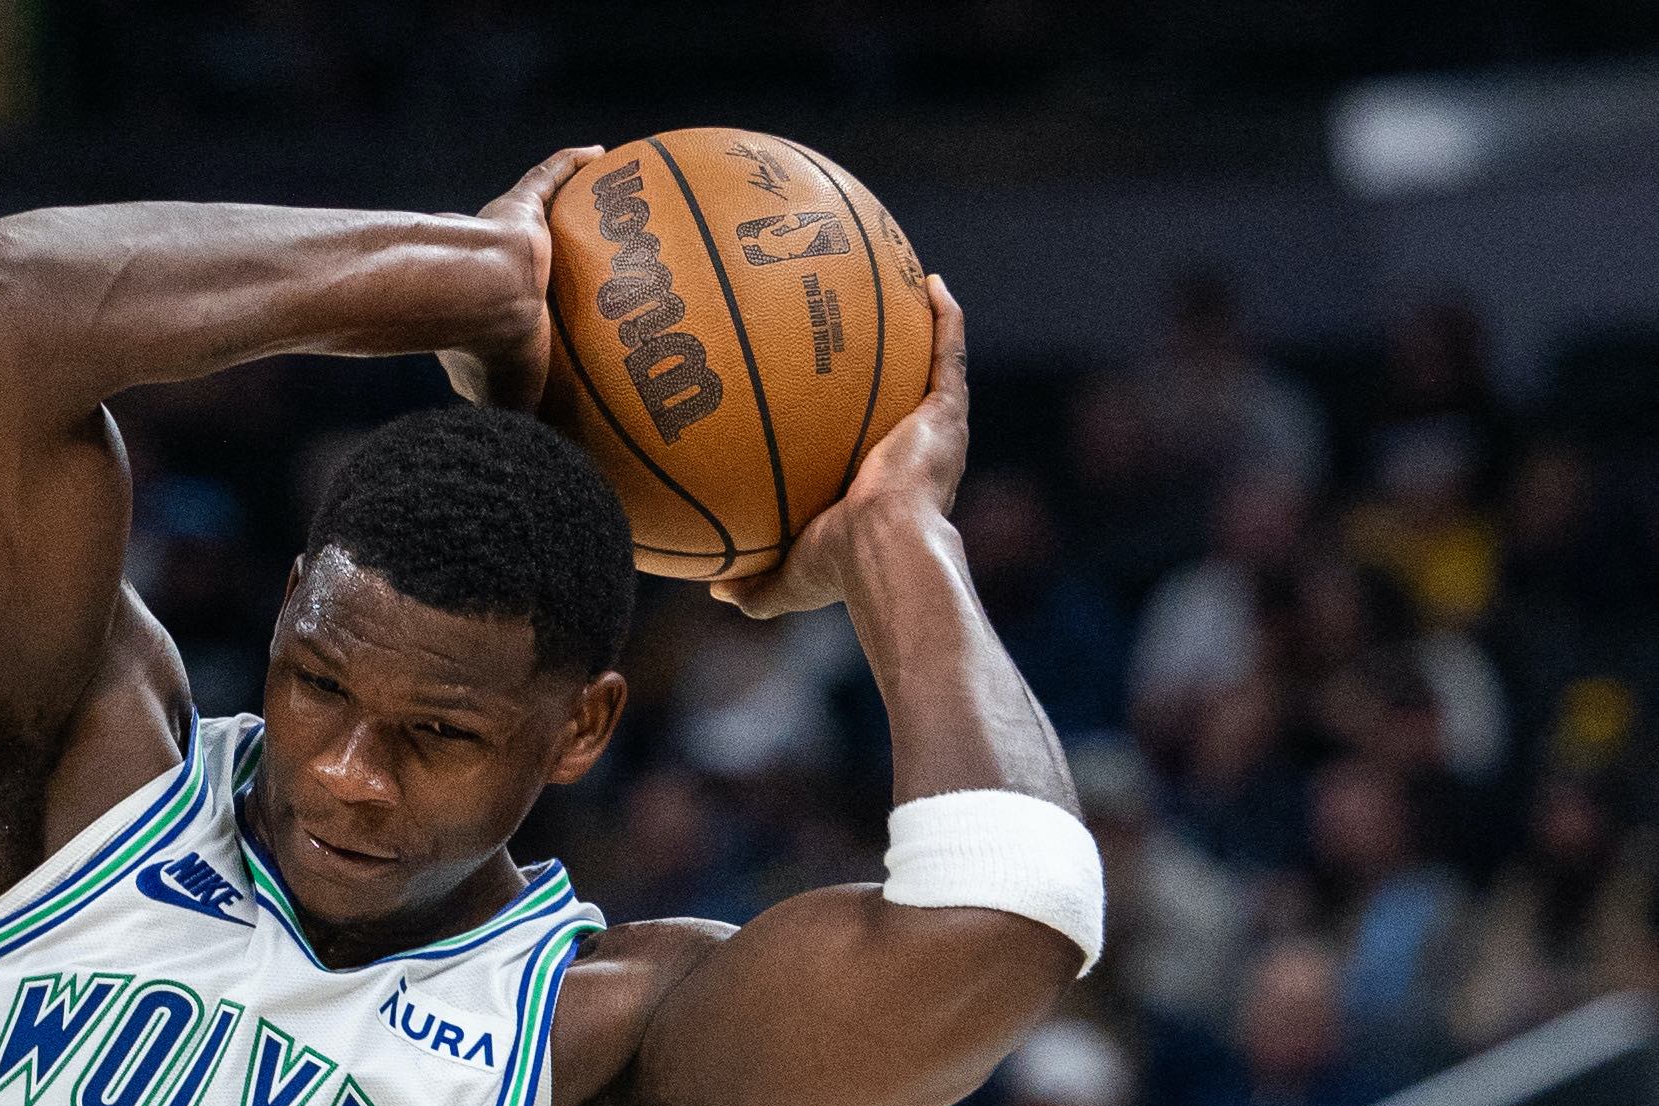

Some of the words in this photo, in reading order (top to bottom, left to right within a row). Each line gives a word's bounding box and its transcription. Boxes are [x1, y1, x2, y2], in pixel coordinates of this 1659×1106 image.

[593, 159, 723, 446] Wilson
[801, 272, 822, 297] BALL
[813, 329, 832, 375] OFFICIAL
[163, 851, 244, 909] NIKE
[379, 975, 495, 1068] AURA
